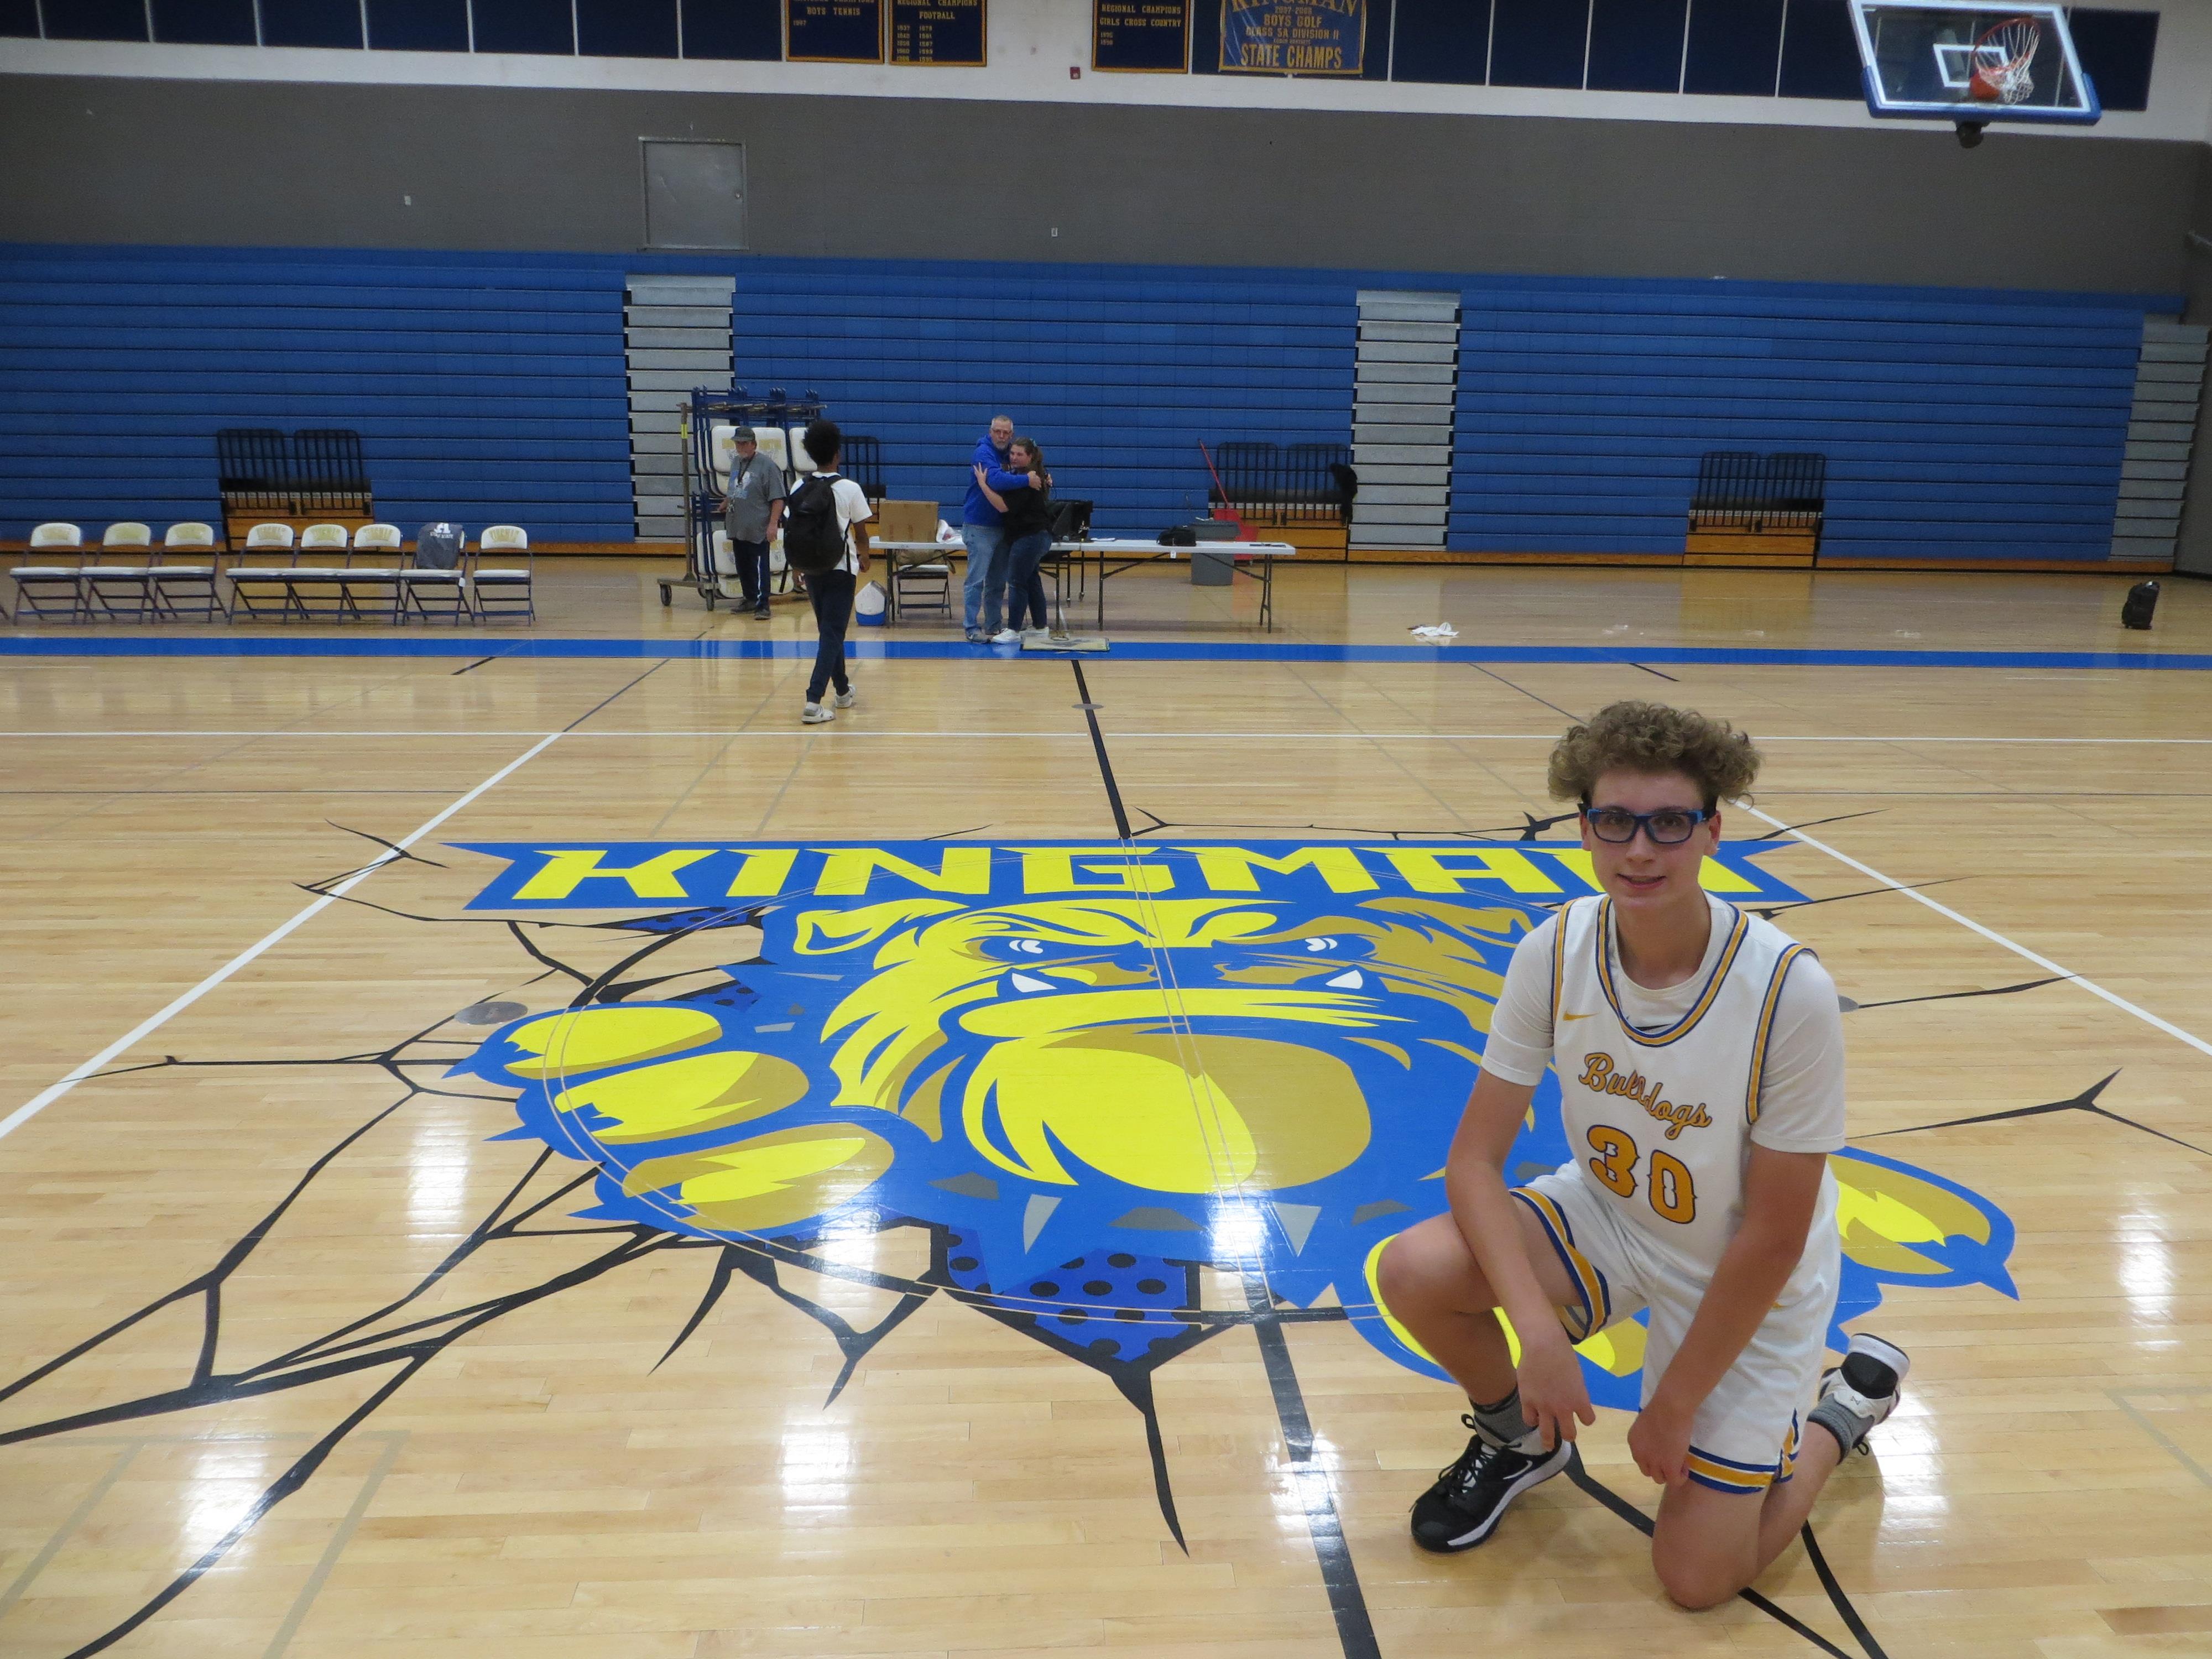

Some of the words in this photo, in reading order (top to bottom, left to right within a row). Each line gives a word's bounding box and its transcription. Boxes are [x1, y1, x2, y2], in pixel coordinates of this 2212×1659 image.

[806, 7, 826, 15] BOYS
[833, 7, 860, 15] TENNIS
[919, 11, 955, 19] FOOTBALL
[1101, 4, 1136, 13] REGIONAL
[1141, 6, 1181, 14] CHAMPIONS
[1099, 17, 1120, 25] GIRLS
[1151, 19, 1182, 27] COUNTRY
[1264, 14, 1291, 27] BOYS
[1297, 15, 1322, 28] GOLF
[1246, 27, 1272, 37] CLASS
[1292, 29, 1329, 40] DIVISION
[1241, 44, 1280, 66] STATE
[1287, 45, 1342, 69] CHAMPS
[1579, 1052, 1712, 1140] Bulldogs
[1587, 1124, 1698, 1224] 30
